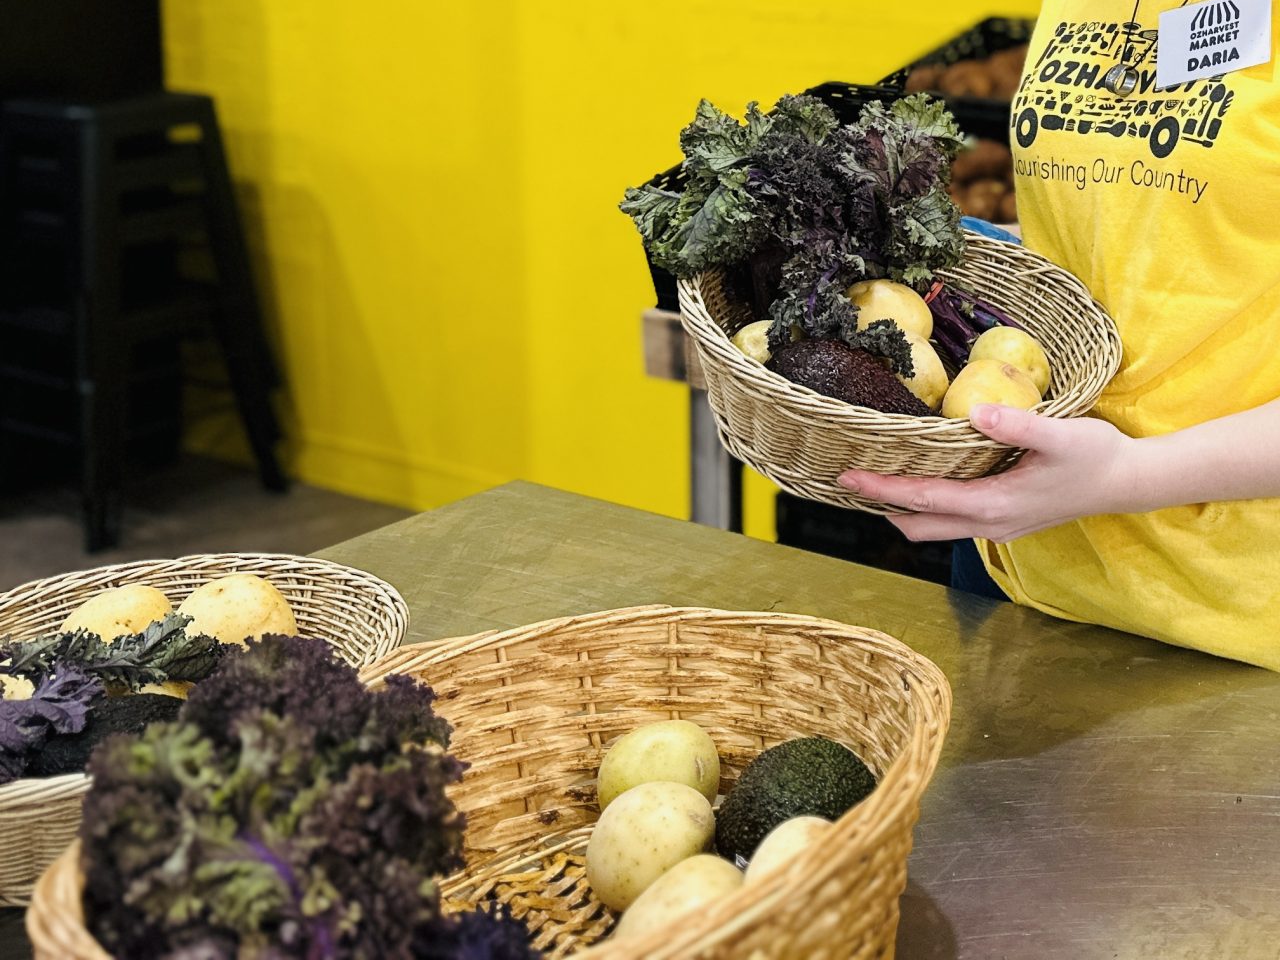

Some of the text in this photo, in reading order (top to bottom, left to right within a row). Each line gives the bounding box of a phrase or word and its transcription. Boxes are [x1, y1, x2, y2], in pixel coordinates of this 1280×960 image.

[1189, 20, 1240, 40] OZHARVEST
[1189, 29, 1240, 51] MARKET
[1187, 47, 1240, 72] DARIA
[1092, 158, 1125, 184] Our
[1130, 160, 1209, 204] Country
